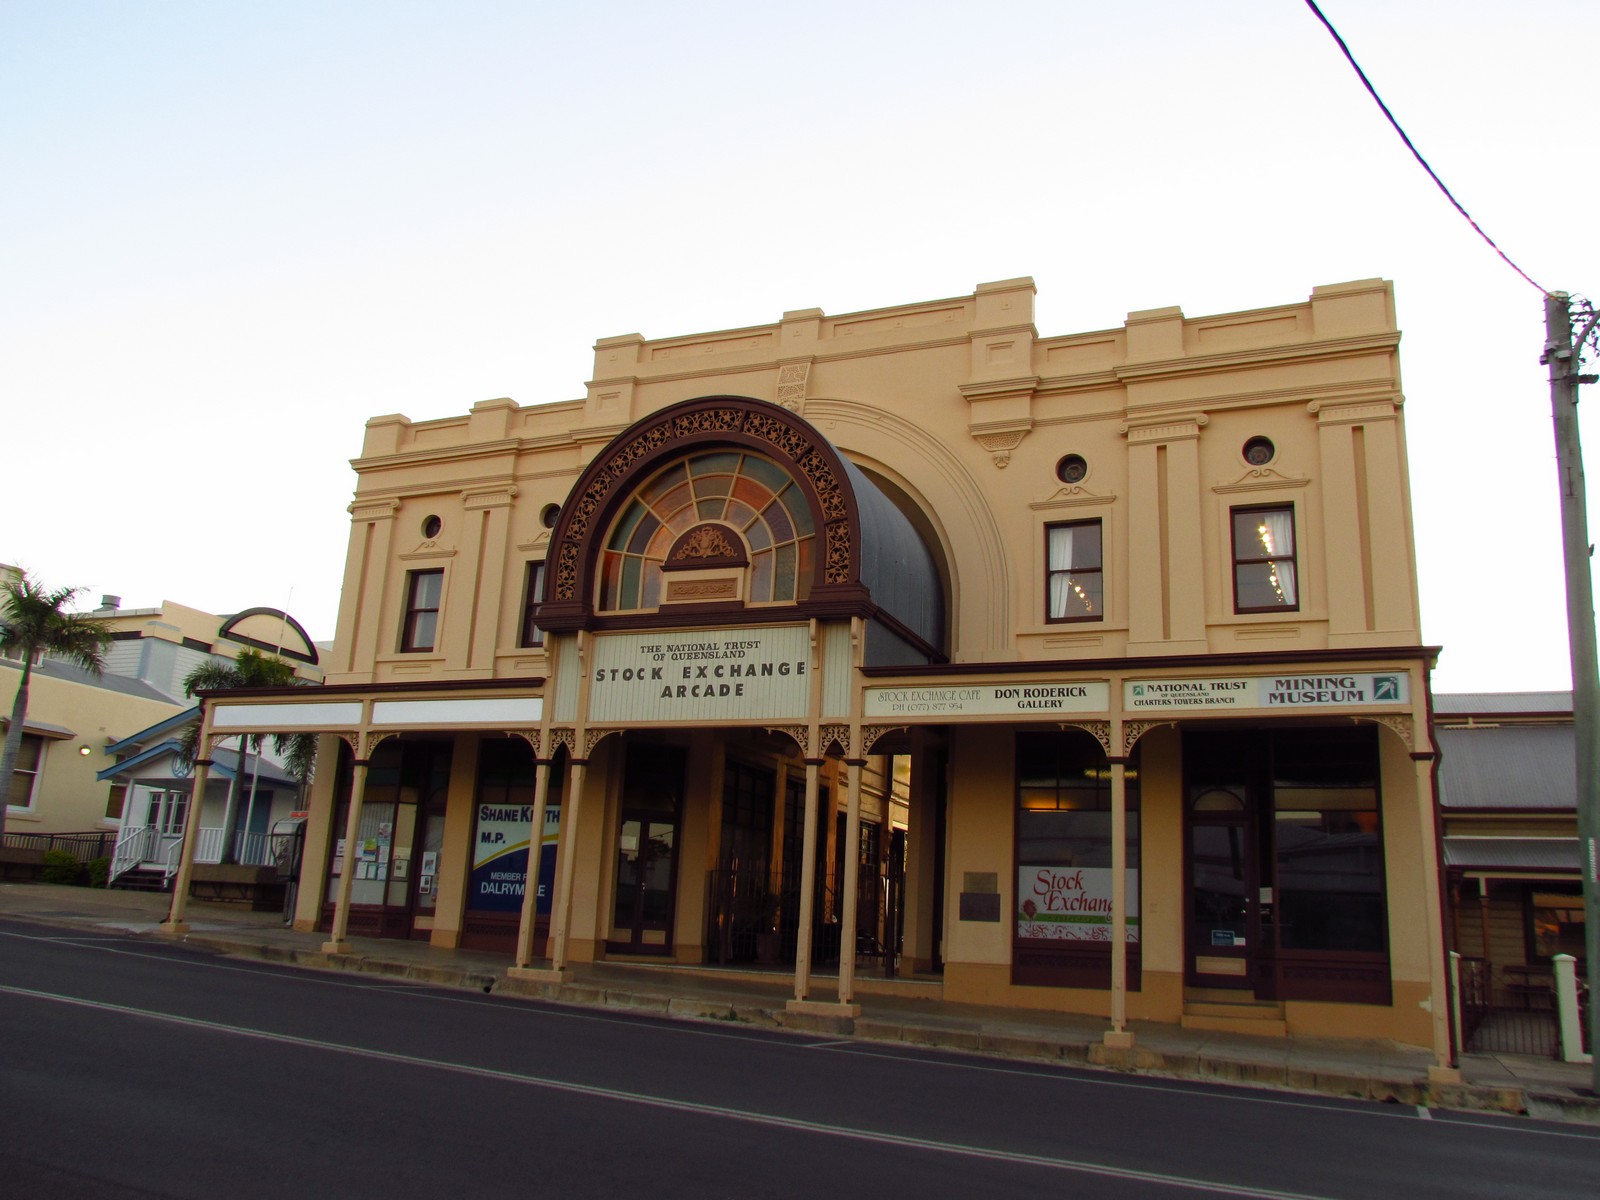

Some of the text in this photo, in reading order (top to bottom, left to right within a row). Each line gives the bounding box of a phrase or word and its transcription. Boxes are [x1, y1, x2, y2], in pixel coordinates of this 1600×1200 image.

[640, 641, 761, 653] THE NATIONAL TRUST
[652, 650, 746, 661] OF QUEENSLAND
[596, 661, 805, 682] STOCK EXCHANGE
[1147, 681, 1248, 692] NATIONAL TRUST
[1275, 677, 1356, 690] MINING
[660, 683, 744, 698] ARCADE
[878, 690, 981, 702] STOCK EXCHANGE CAFE
[994, 686, 1087, 699] DON RODERICK
[1133, 698, 1171, 706] CHARTERS
[1174, 697, 1203, 706] TOWERS
[1269, 690, 1364, 704] MUSEUM
[1017, 699, 1064, 709] GALLERY
[480, 805, 560, 823] SHANE KTH
[480, 832, 506, 844] M.P.
[490, 871, 521, 881] MEMBER
[1033, 869, 1083, 896] Stock
[480, 881, 546, 897] DALRYME
